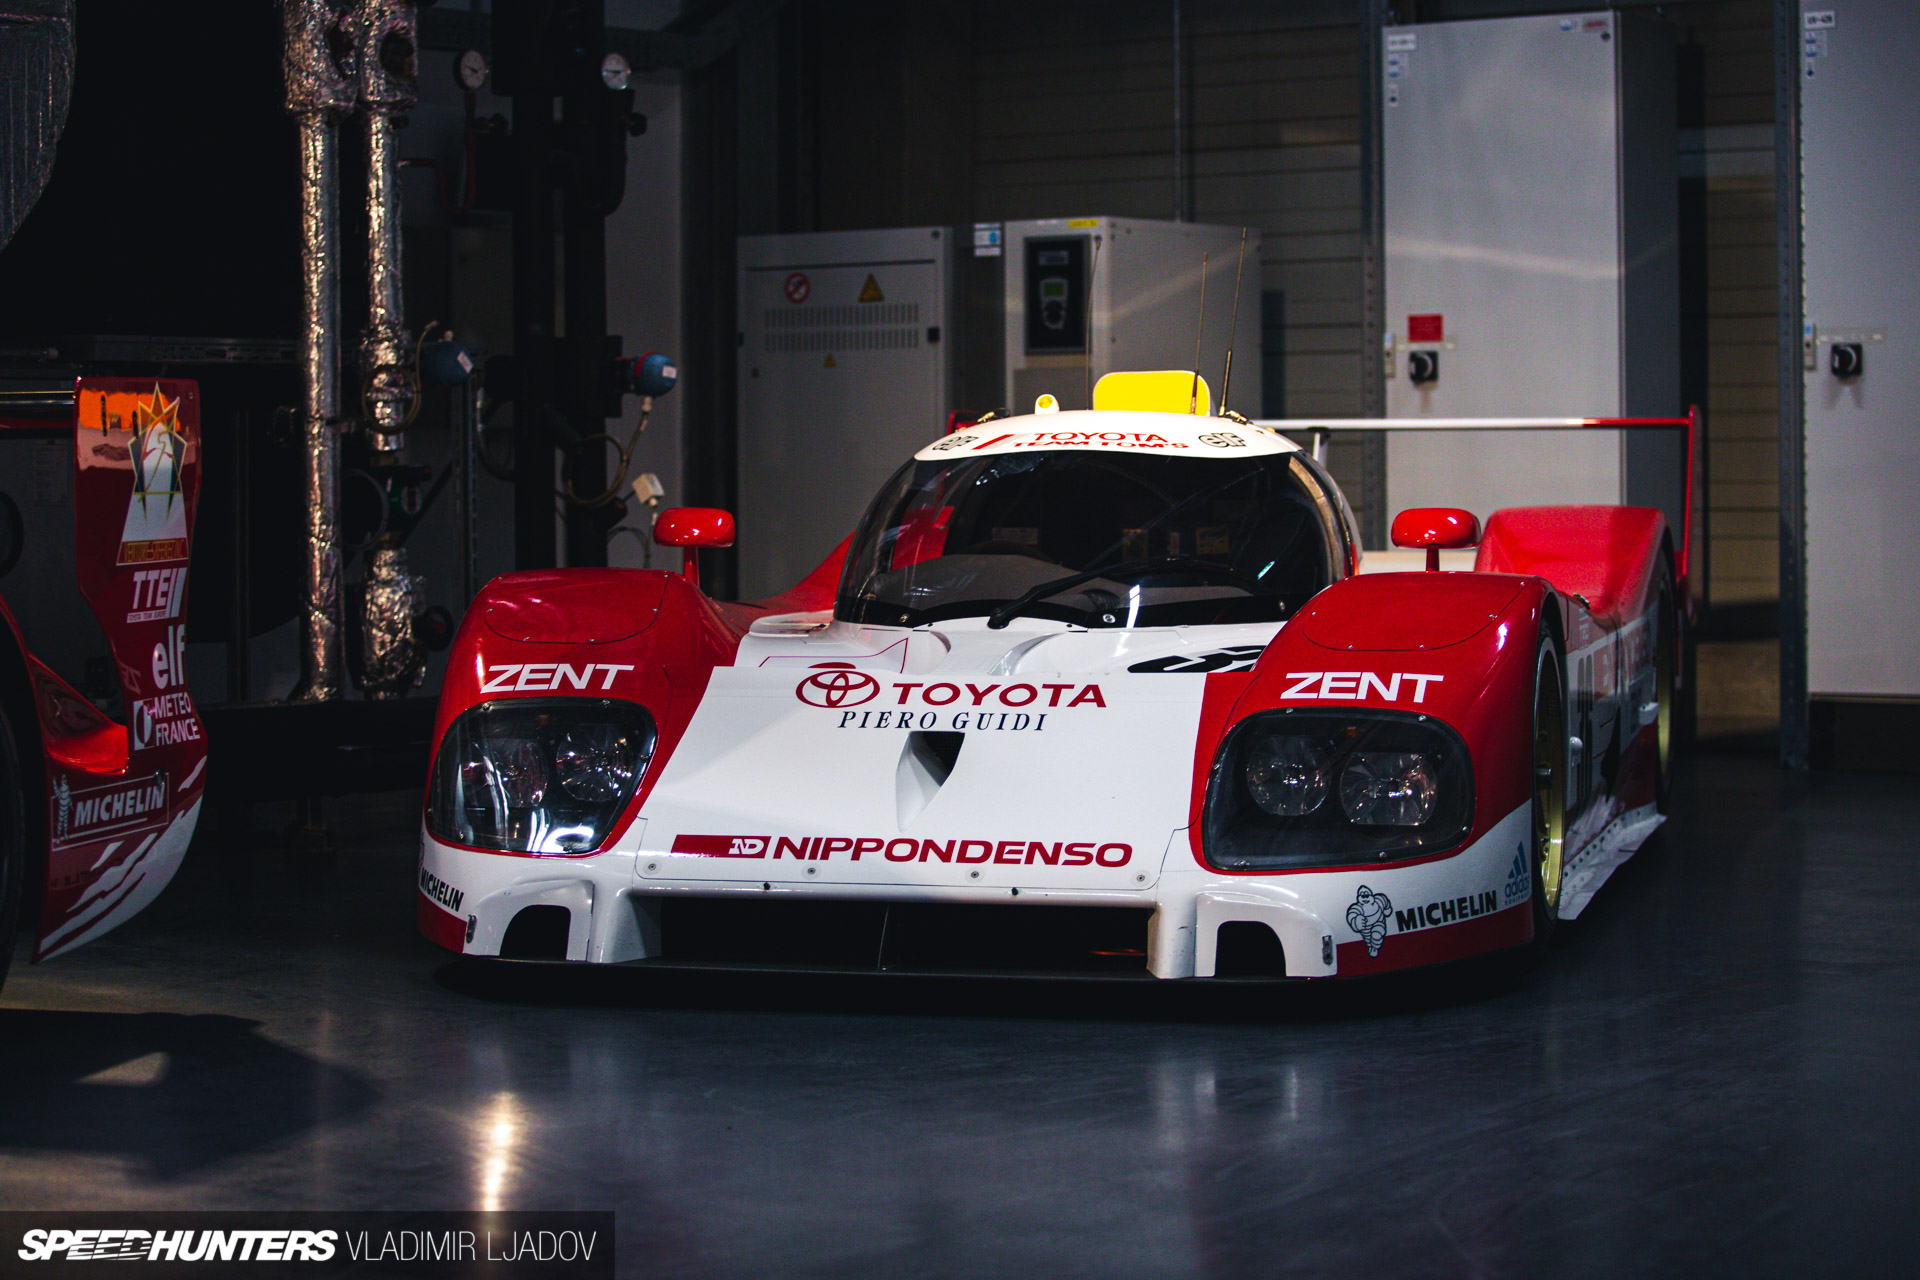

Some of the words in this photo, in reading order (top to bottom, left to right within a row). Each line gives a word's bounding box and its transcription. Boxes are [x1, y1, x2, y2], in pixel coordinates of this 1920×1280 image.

[1034, 432, 1169, 443] TOYOTA
[1100, 441, 1189, 449] TOM'S
[1199, 432, 1246, 448] elf
[133, 568, 172, 609] TTE
[152, 623, 185, 690] elf
[480, 663, 635, 694] ZENT
[1280, 671, 1444, 703] ZENT
[154, 692, 191, 719] METEO
[892, 682, 1107, 708] TOYOTA
[155, 718, 201, 747] FRANCE
[837, 710, 938, 730] PIERO
[951, 711, 1047, 732] GUIDI
[74, 784, 165, 828] MICHELIN
[772, 836, 1134, 868] NIPPONDENSO
[420, 867, 464, 912] MICHELIN
[1504, 874, 1530, 899] adidas
[1395, 890, 1497, 932] MICHELIN
